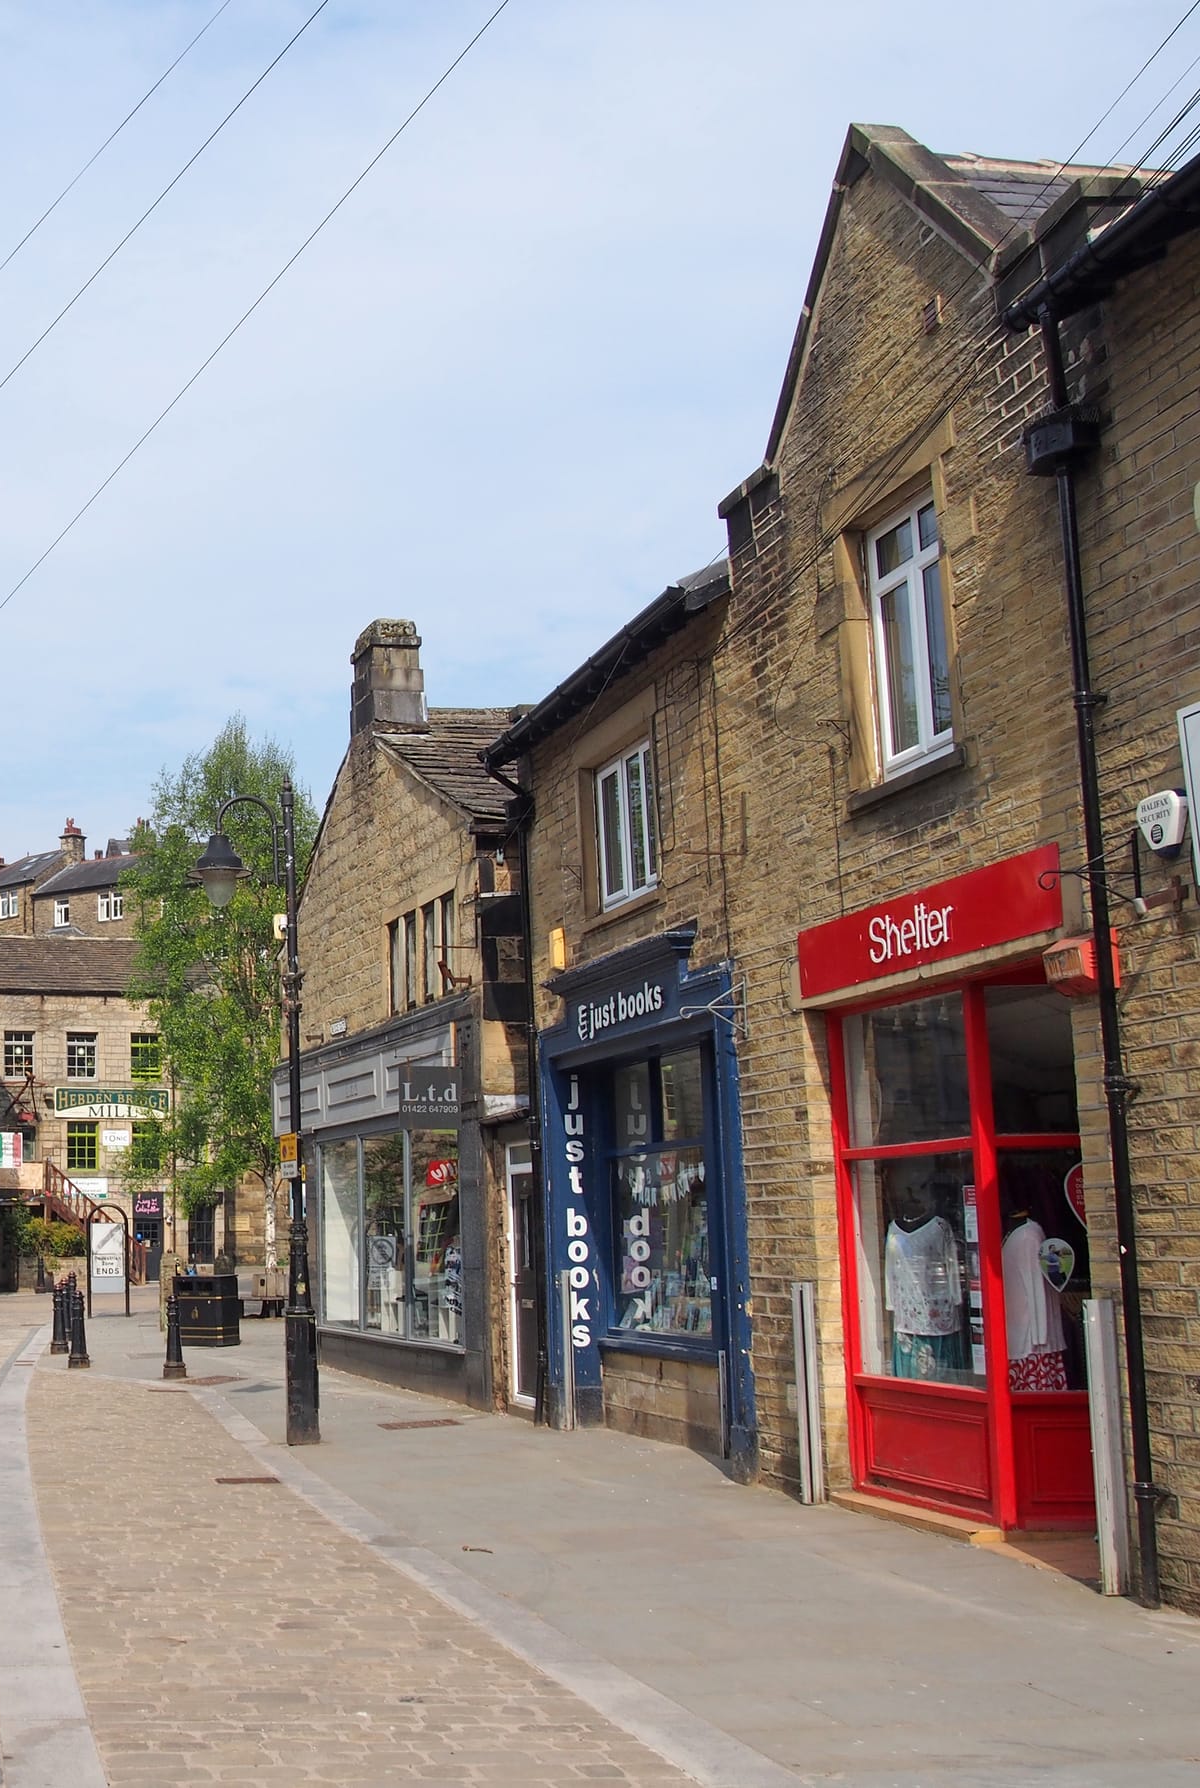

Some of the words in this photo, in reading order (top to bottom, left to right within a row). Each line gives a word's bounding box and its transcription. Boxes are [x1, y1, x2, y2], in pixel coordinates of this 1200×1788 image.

[1141, 797, 1169, 813] HALIFAX
[1140, 808, 1171, 824] SECURITY
[869, 902, 954, 964] Shelter
[589, 995, 616, 1040] just
[618, 981, 663, 1022] books
[58, 1091, 113, 1111] HEBDEN
[117, 1091, 167, 1110] BRDGE
[402, 1082, 458, 1102] L.t.d
[402, 1104, 427, 1113] 01422
[429, 1105, 459, 1114] 647909
[564, 1074, 585, 1194] just
[566, 1208, 591, 1347] books
